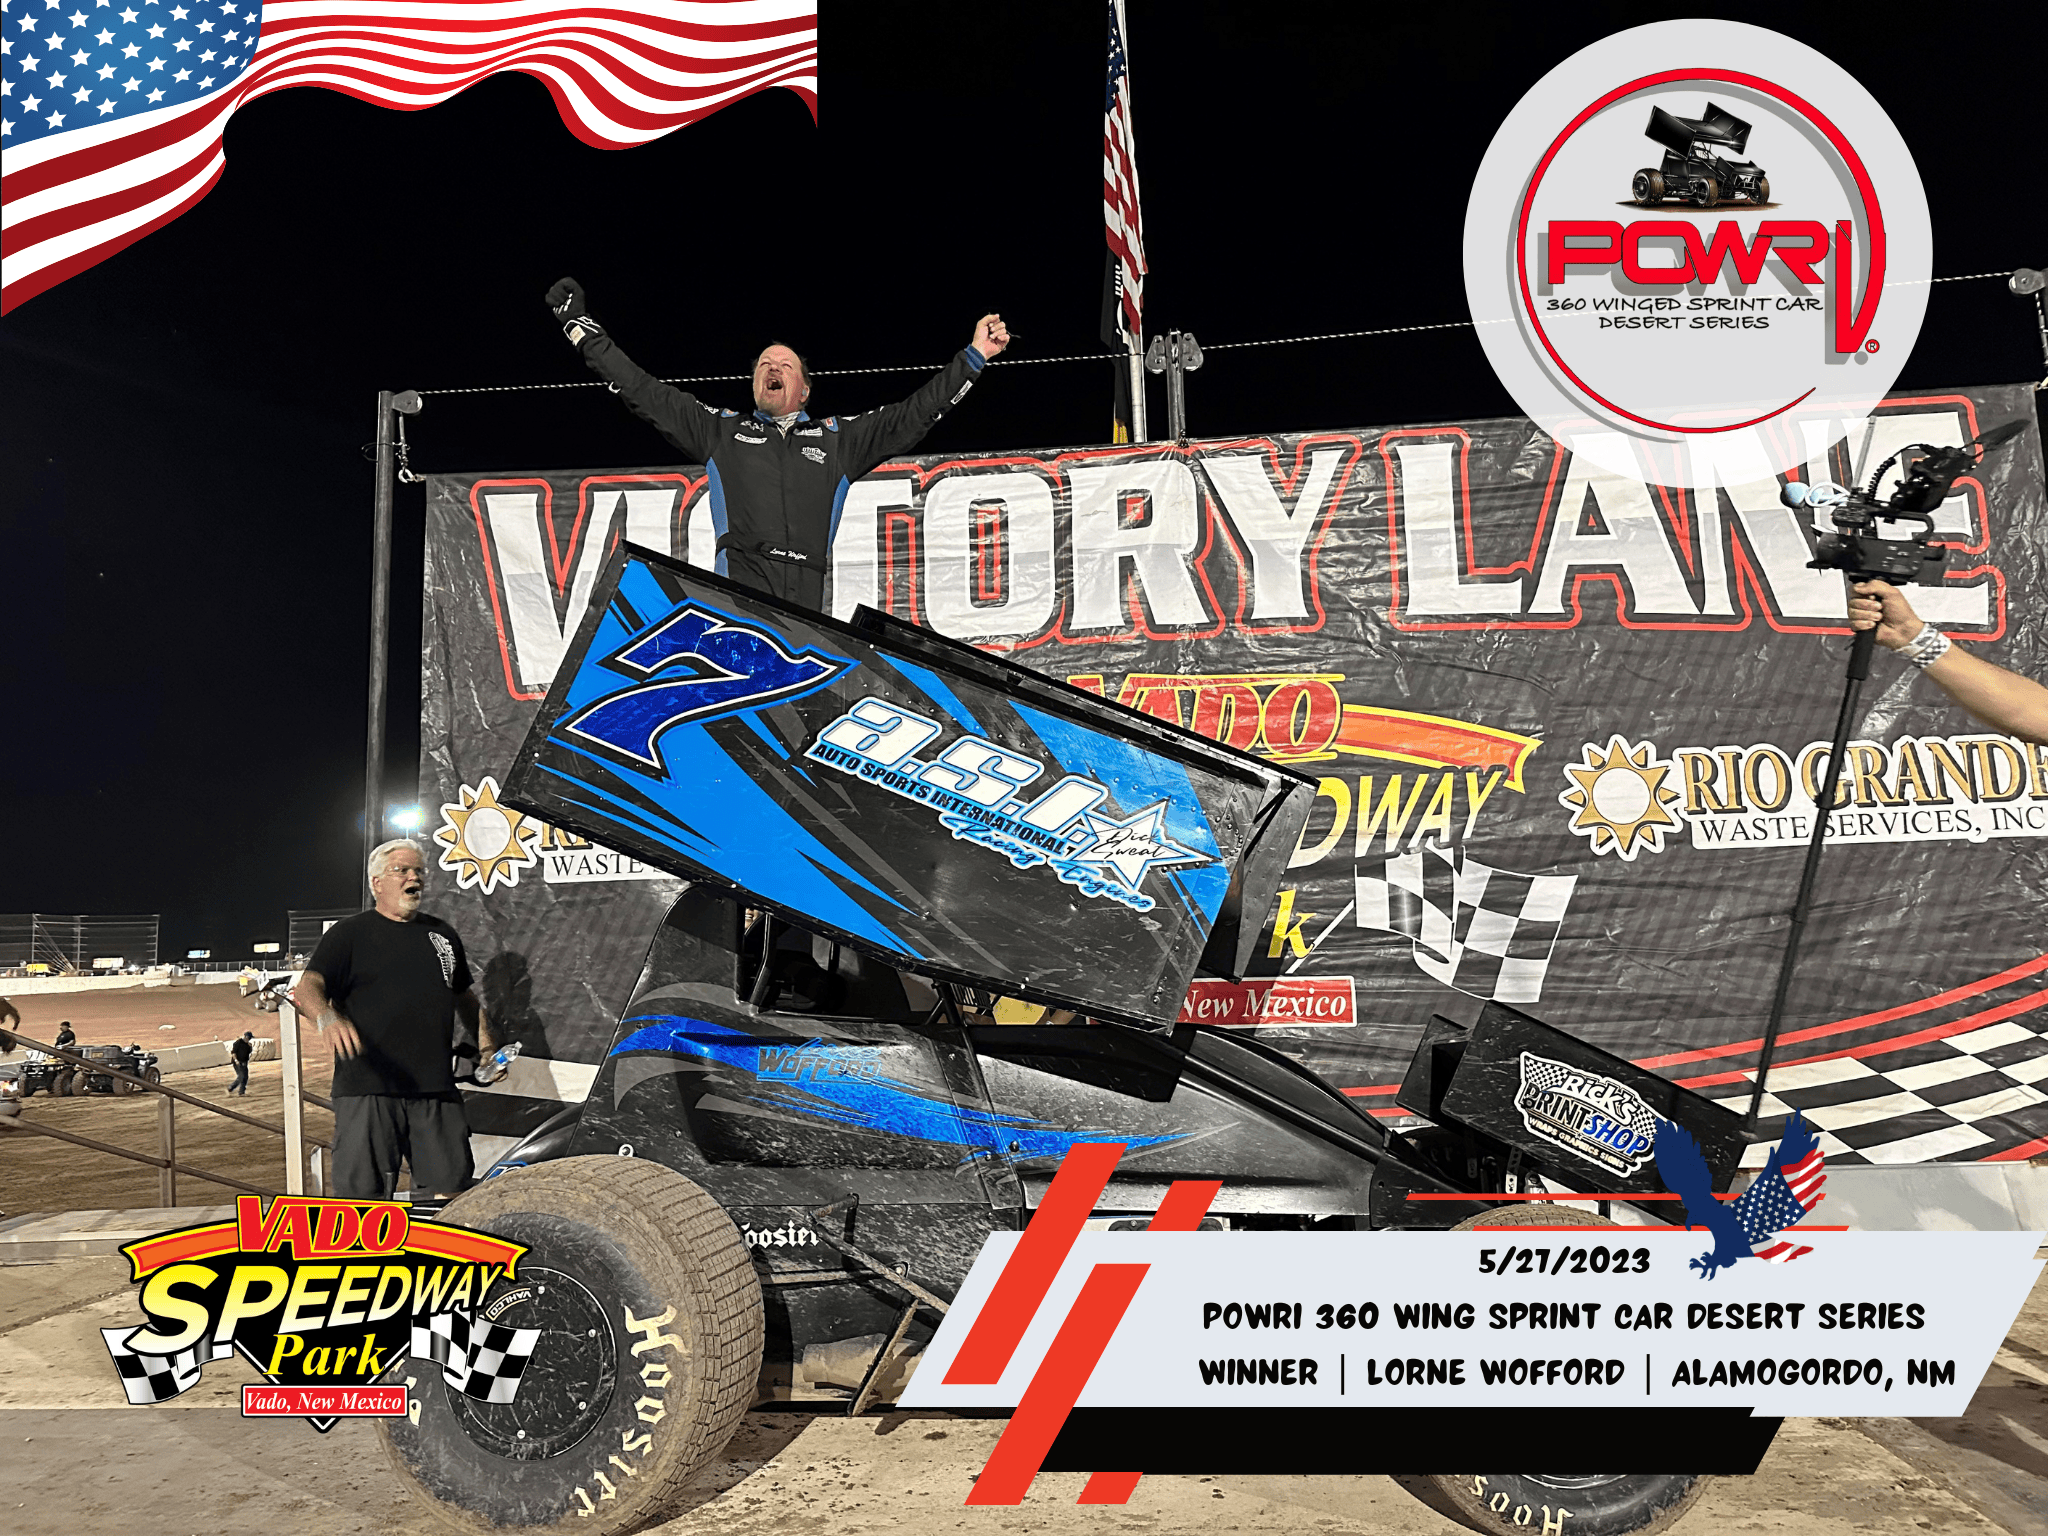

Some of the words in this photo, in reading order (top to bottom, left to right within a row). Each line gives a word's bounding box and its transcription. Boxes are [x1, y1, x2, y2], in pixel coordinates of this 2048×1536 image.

[1392, 408, 1993, 628] LANE
[562, 604, 844, 774] 7
[812, 743, 861, 771] AUTO
[860, 760, 931, 800] SPORTS
[930, 789, 1068, 855] INTERNATIONAL
[1678, 748, 1792, 814] RIO
[942, 813, 1045, 865] Racing
[1699, 816, 1811, 844] WASTE
[550, 852, 645, 878] WASTE
[1241, 986, 1348, 1019] Mexico
[1528, 1116, 1559, 1137] WRAPS
[1558, 1130, 1601, 1157] GRAPHICS
[1599, 1151, 1626, 1169] SIGNS
[741, 1219, 820, 1250] oosier
[489, 1290, 532, 1316] VAHLCO
